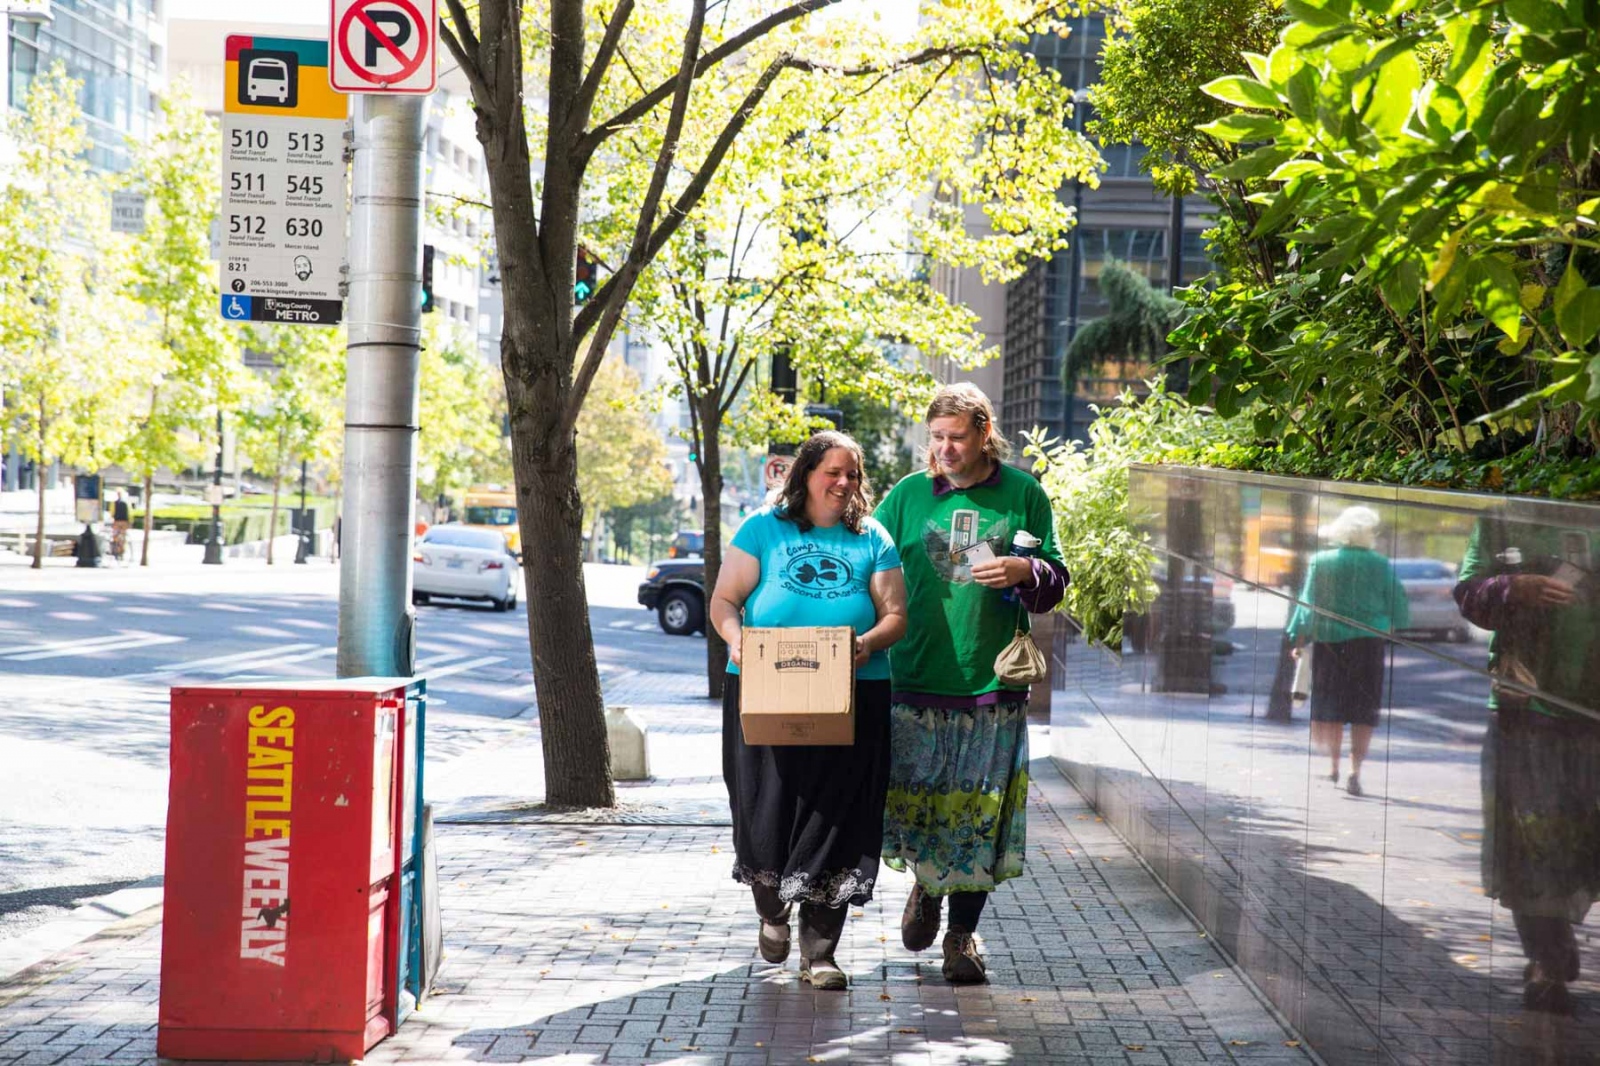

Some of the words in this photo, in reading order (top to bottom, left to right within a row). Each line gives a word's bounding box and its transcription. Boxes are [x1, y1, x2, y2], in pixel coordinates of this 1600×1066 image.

[365, 10, 411, 67] P
[232, 129, 268, 148] 510
[288, 132, 324, 152] 513
[230, 172, 265, 192] 511
[287, 175, 324, 195] 545
[230, 214, 266, 234] 512
[286, 218, 323, 238] 630
[228, 262, 247, 272] 821
[276, 310, 320, 321] METRO
[786, 544, 813, 556] Camp
[781, 582, 822, 599] Second
